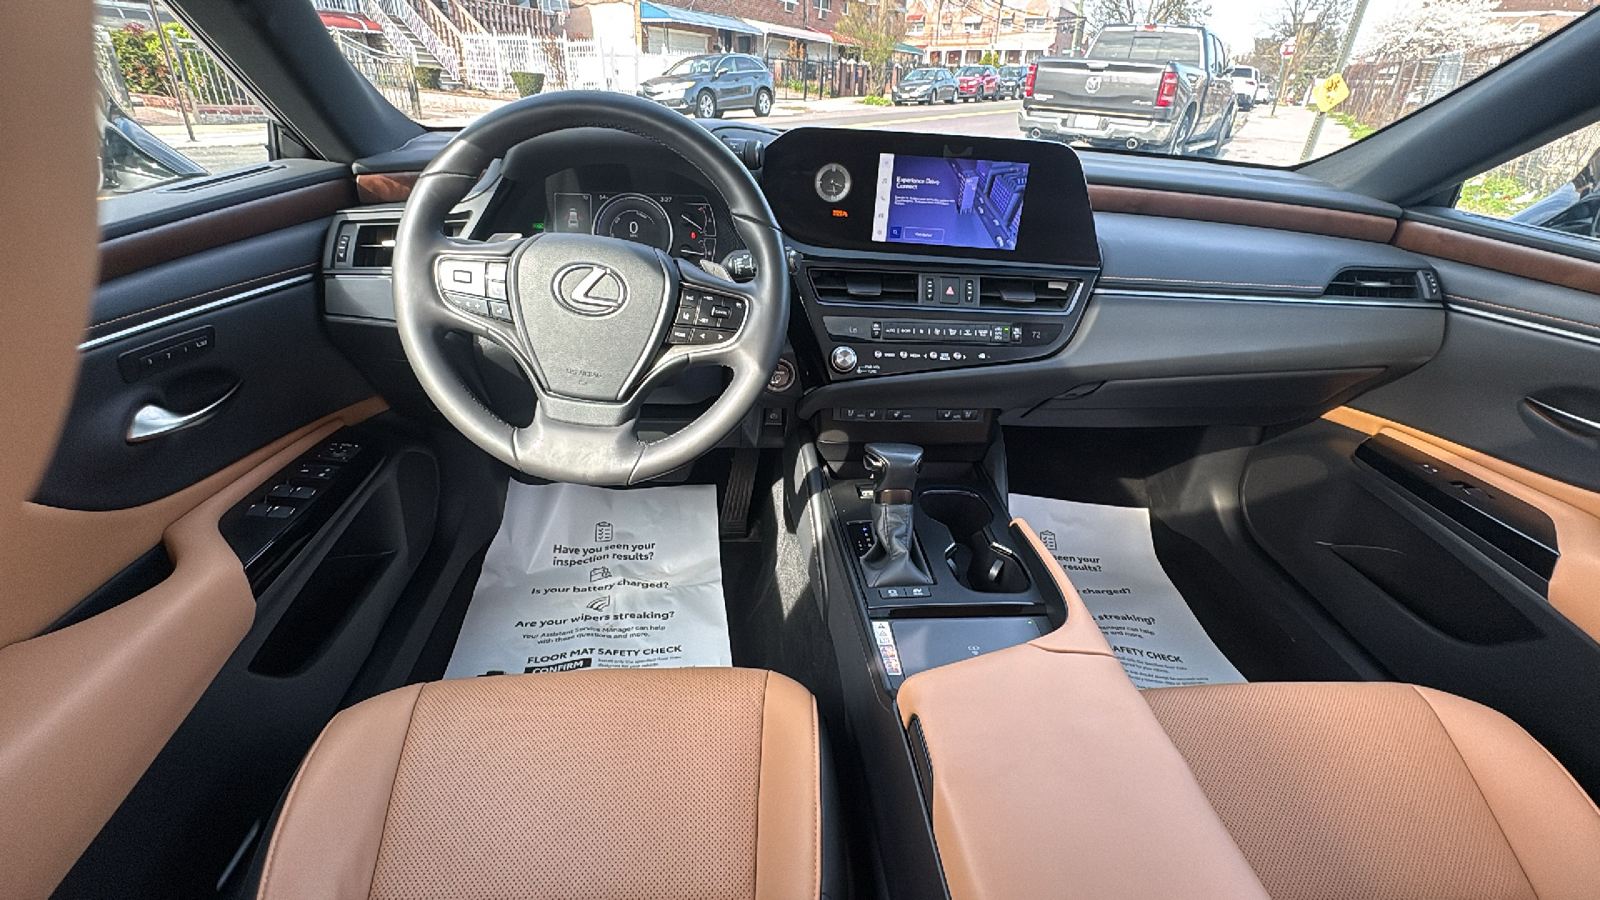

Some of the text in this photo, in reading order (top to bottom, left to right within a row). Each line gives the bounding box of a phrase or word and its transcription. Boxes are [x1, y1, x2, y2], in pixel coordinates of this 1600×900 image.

[629, 221, 638, 234] 0
[553, 544, 580, 555] Have
[582, 547, 602, 556] you
[631, 542, 655, 552] your
[553, 551, 654, 567] inspection results?
[1076, 556, 1100, 564] your
[1063, 564, 1102, 572] results?
[543, 586, 570, 595] your
[572, 583, 615, 593] battery
[617, 578, 669, 589] charged?
[539, 618, 568, 628] your
[571, 613, 610, 622] wipers
[613, 611, 675, 620] streaking?
[1098, 614, 1155, 625] streaking?
[541, 629, 574, 638] Assistant
[555, 635, 575, 643] these
[576, 631, 612, 639] questions
[527, 645, 682, 664] FLOOR MAT SAFETY CHECK
[1112, 645, 1184, 663] AFETY CHECK
[532, 660, 584, 673] CONFIRM
